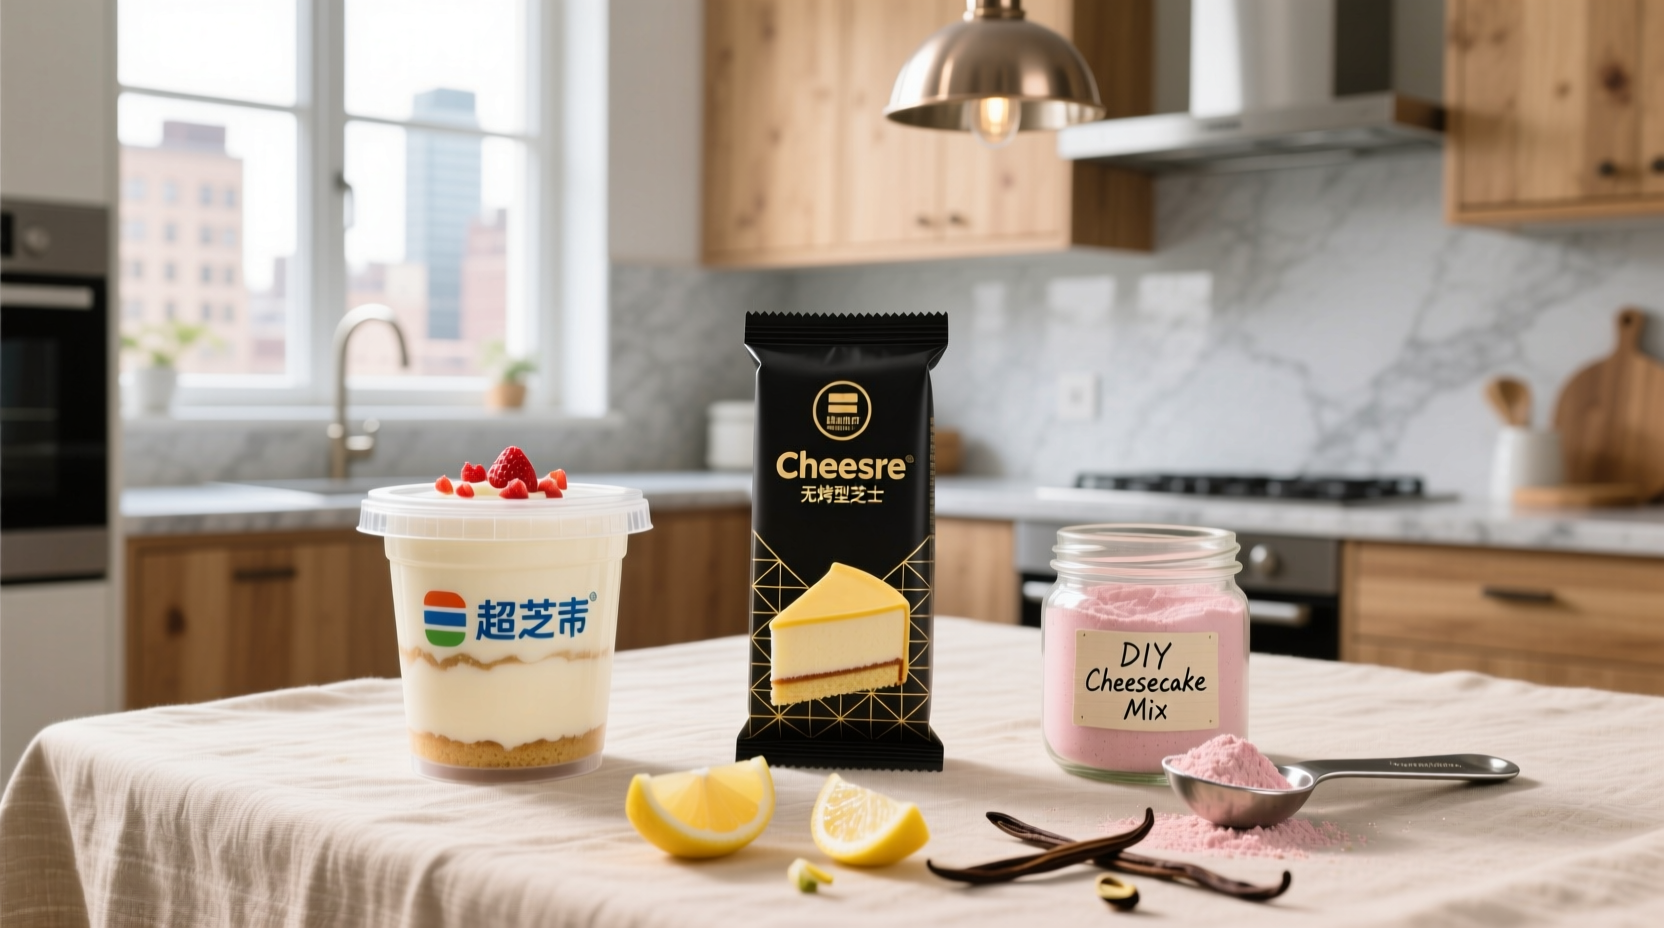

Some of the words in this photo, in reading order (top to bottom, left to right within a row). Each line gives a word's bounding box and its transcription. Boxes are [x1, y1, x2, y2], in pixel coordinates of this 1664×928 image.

[1120, 641, 1172, 670] DIY
[1085, 666, 1207, 692] Cheesecake
[1123, 697, 1167, 721] Mix
